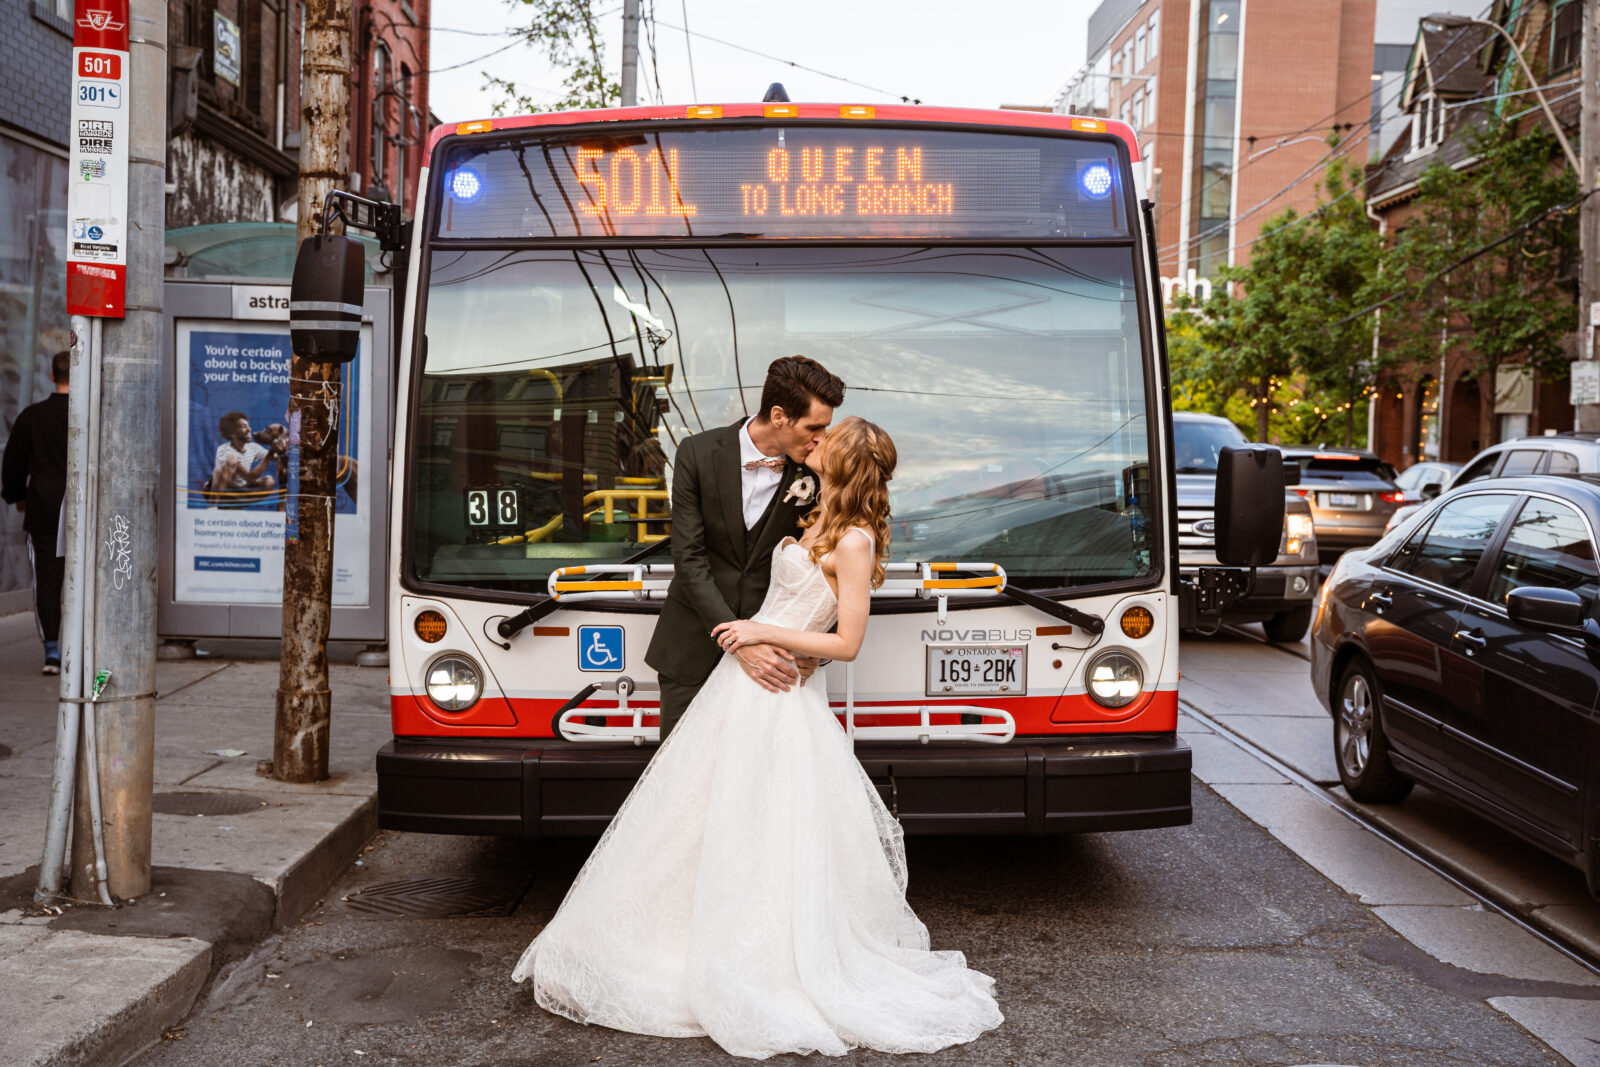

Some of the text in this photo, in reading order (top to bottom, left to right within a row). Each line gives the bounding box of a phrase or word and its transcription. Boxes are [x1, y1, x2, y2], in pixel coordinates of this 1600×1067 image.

[84, 56, 111, 75] 501
[80, 85, 105, 102] 301
[79, 120, 113, 130] DIRE
[79, 138, 113, 148] DIRE
[577, 147, 922, 216] 501L QUEEN
[740, 183, 954, 216] TO LONG BRANCH
[249, 295, 290, 309] astra
[204, 345, 282, 358] You're certain
[204, 357, 289, 373] about a backy
[204, 373, 230, 384] your
[232, 371, 257, 383] best
[194, 518, 205, 526] Be
[207, 518, 237, 527] certain
[238, 519, 263, 528] about
[194, 528, 217, 537] home
[219, 530, 234, 539] you
[236, 530, 259, 539] could
[958, 648, 997, 657] ONTARIO
